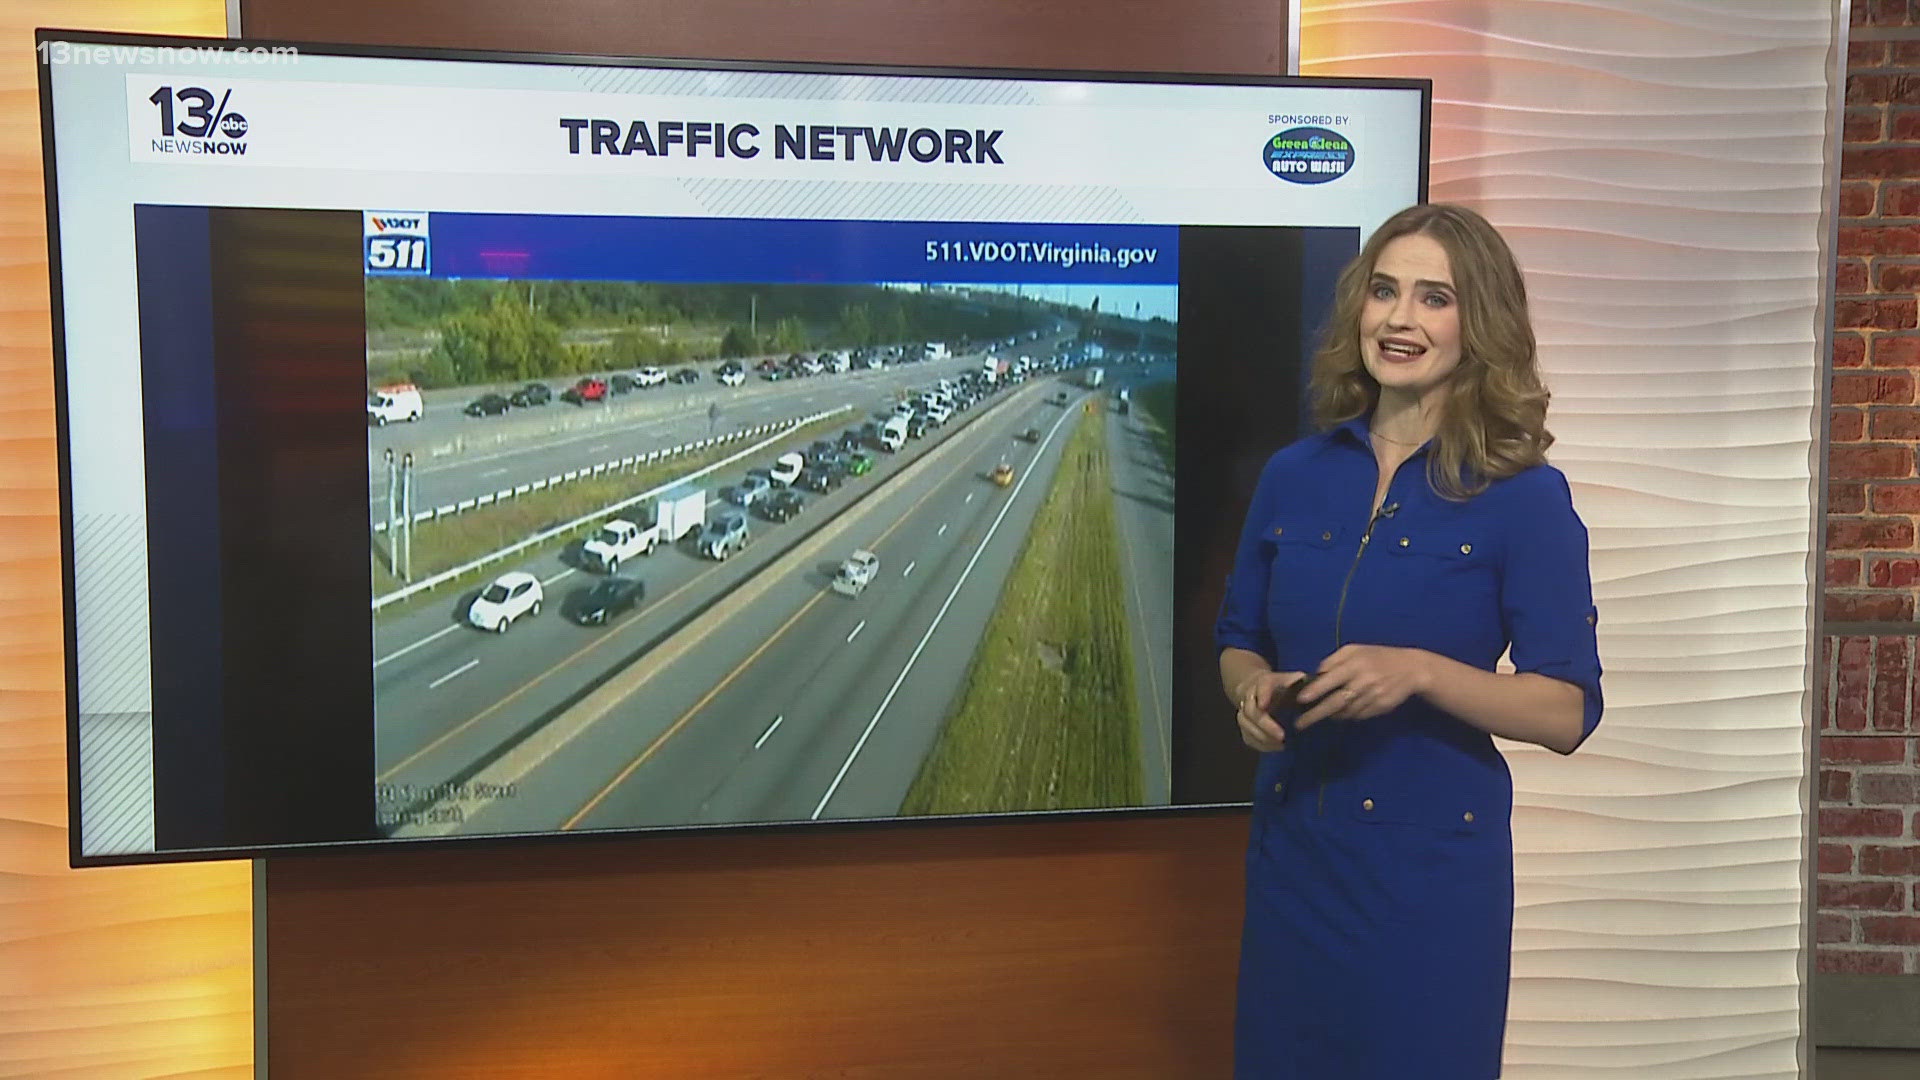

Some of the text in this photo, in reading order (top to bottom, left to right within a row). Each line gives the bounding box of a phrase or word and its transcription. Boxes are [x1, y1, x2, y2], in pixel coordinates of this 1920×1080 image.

[221, 117, 248, 132] abc
[1268, 114, 1349, 125] SPONSORED BY
[559, 118, 1005, 164] TRAFFIC NETWORK
[1272, 135, 1348, 150] Green Clean
[1272, 160, 1345, 174] AUTO WASH
[368, 239, 425, 269] 511
[926, 240, 1158, 268] 511.VDOT.Virginia.gov
